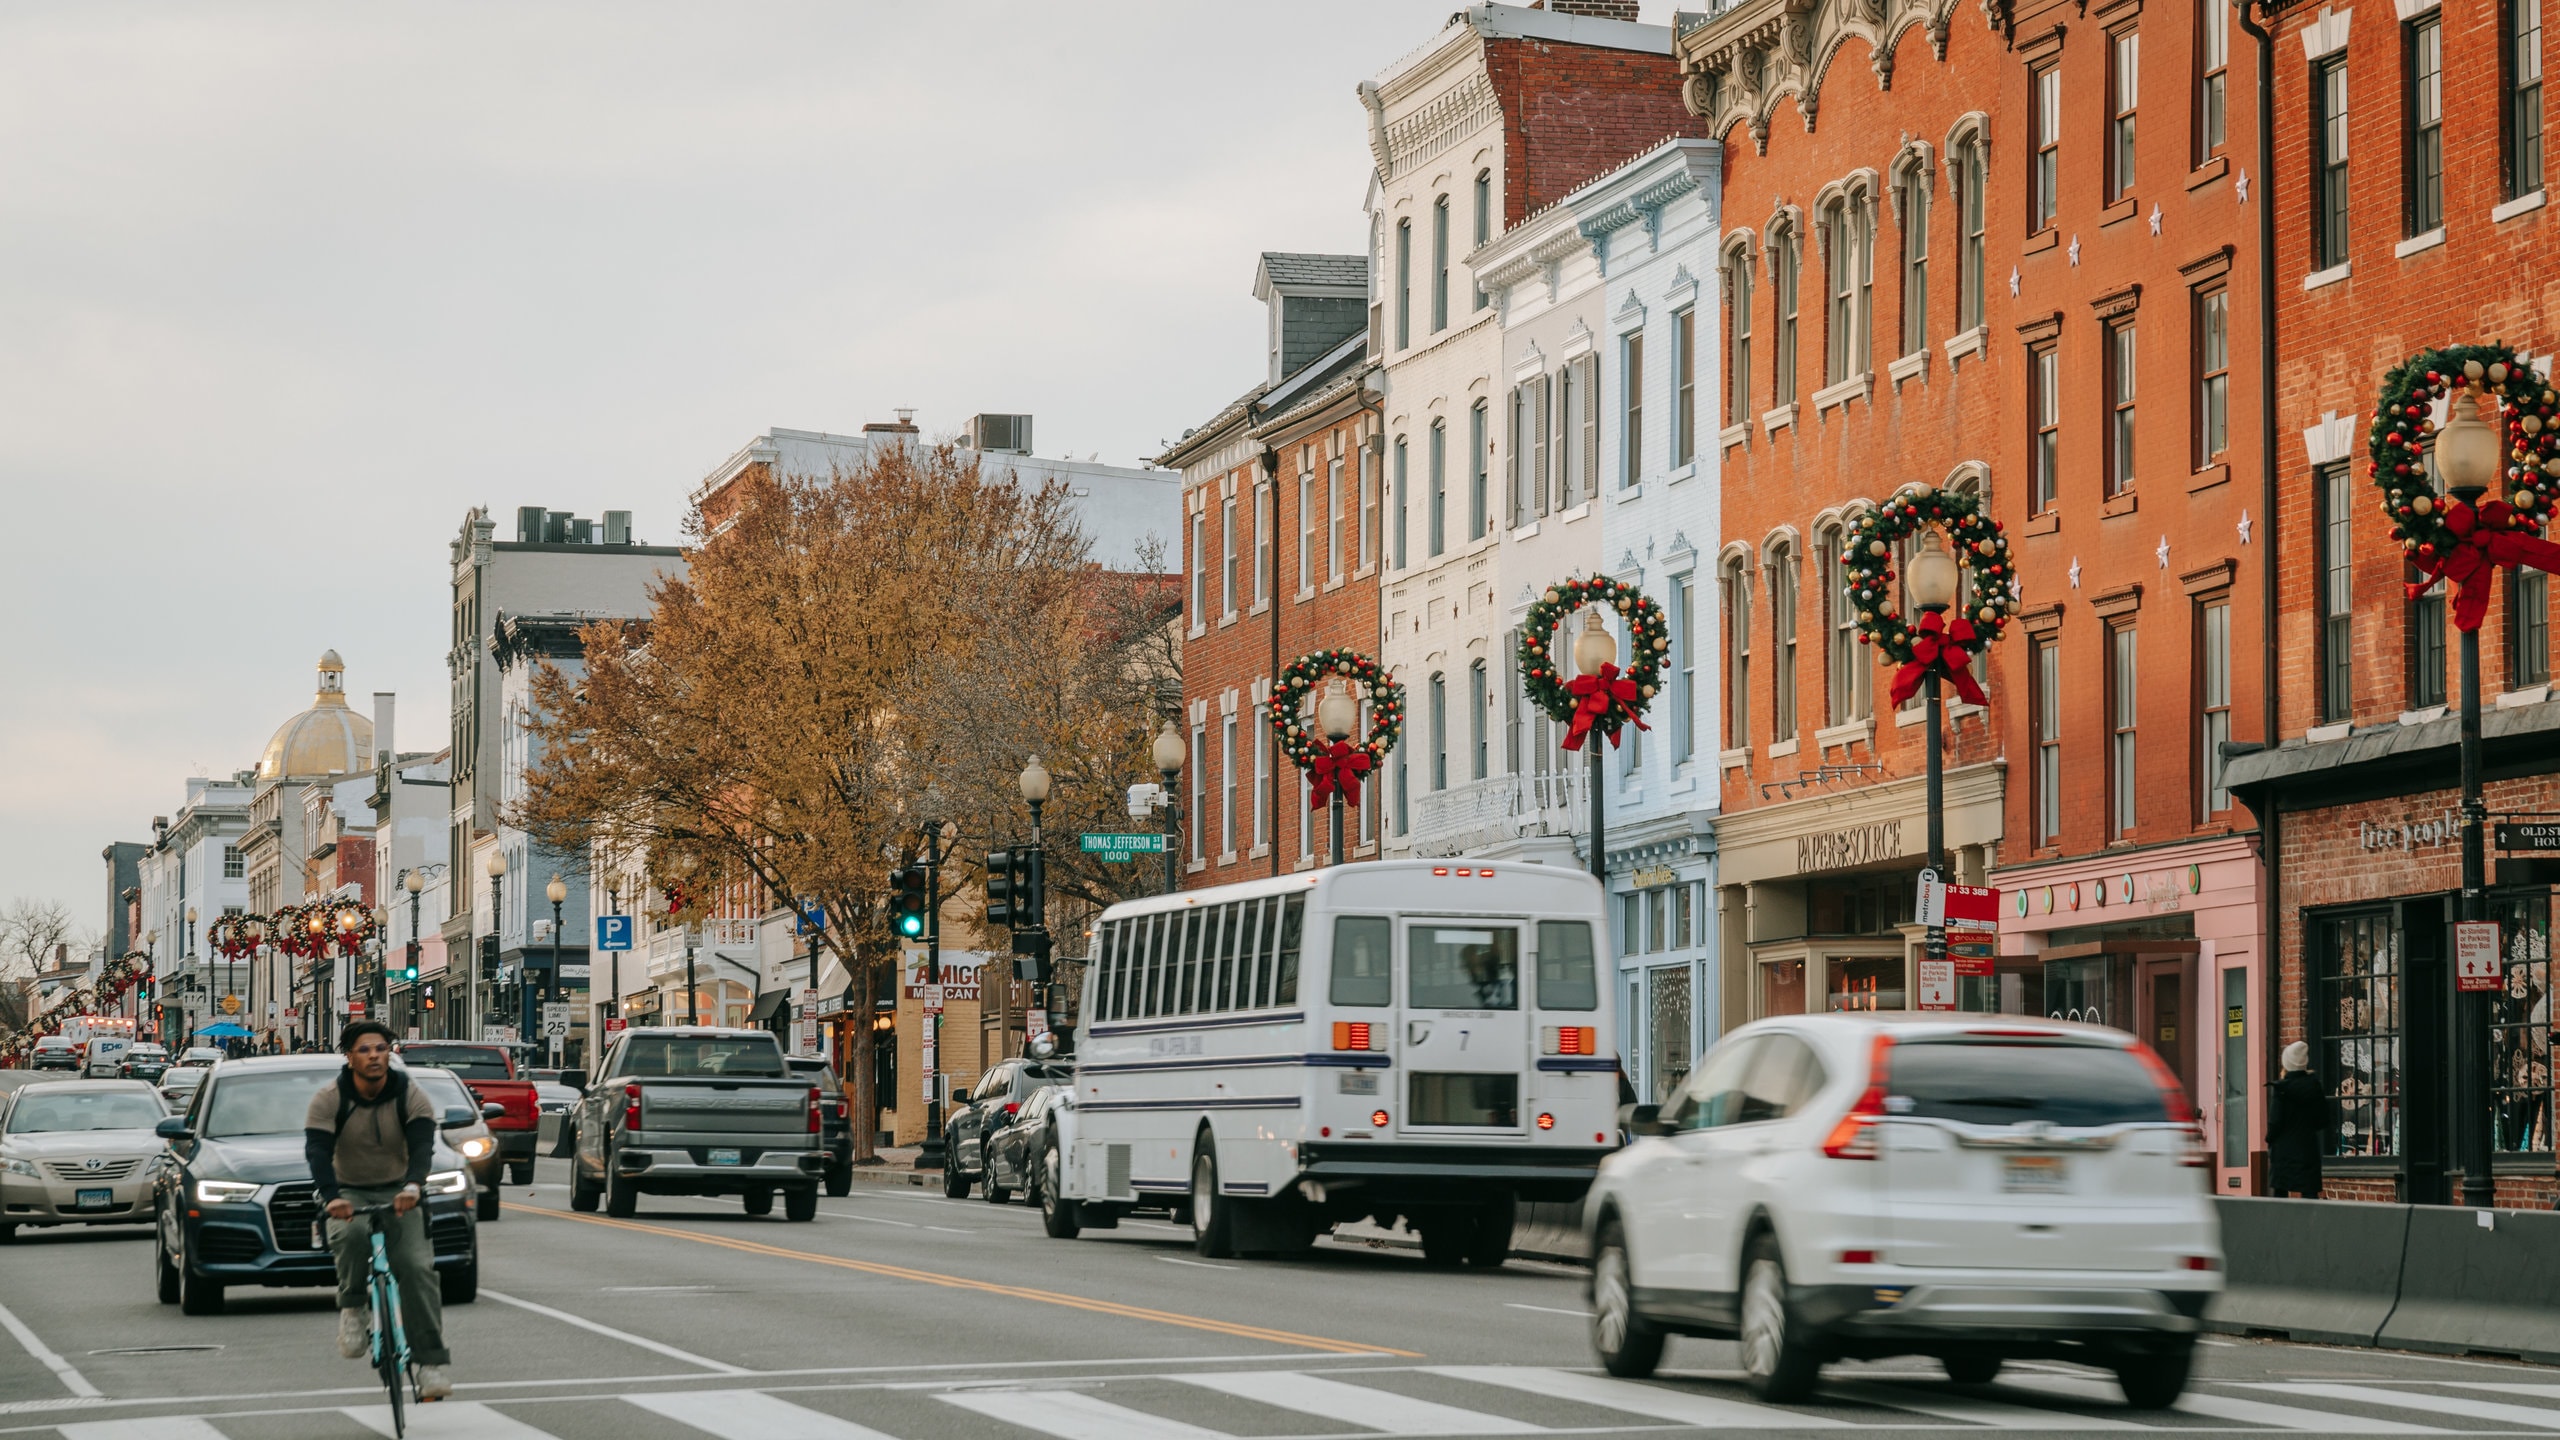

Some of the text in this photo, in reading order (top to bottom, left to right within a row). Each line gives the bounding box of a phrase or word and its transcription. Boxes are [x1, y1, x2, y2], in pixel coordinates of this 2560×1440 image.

[2361, 810, 2460, 853] free people
[2520, 827, 2547, 836] OLD
[1084, 836, 1111, 849] THOMAS
[1113, 836, 1151, 849] JEFFERSON
[1104, 851, 1130, 860] 1000
[1797, 832, 1838, 873] PAPER
[1960, 887, 1970, 895] 33
[1972, 888, 1988, 896] 38B
[1922, 883, 1931, 923] metrobus
[606, 919, 623, 939] P
[913, 988, 973, 999] MCAN
[547, 1022, 566, 1035] 25
[1459, 1030, 1470, 1051] 7
[101, 1043, 123, 1053] ECHO
[653, 1096, 801, 1110] CHEVROLET
